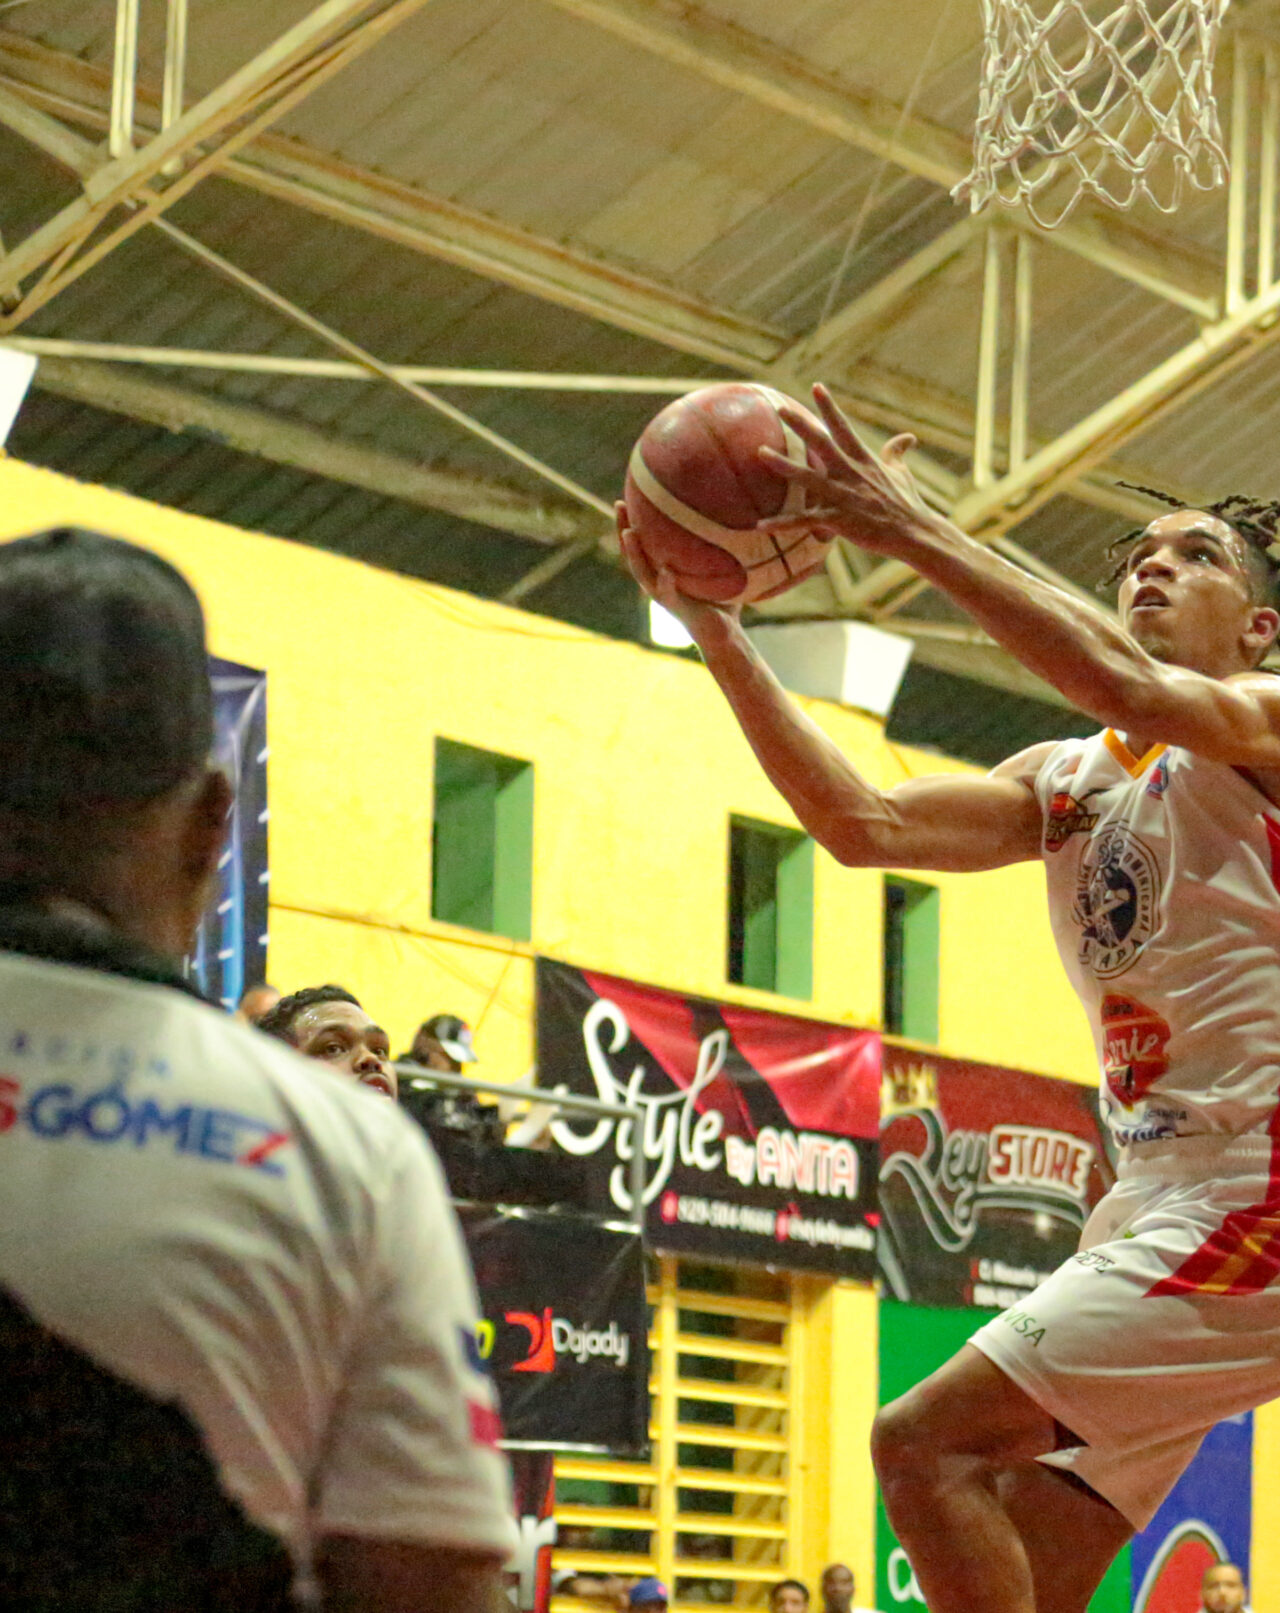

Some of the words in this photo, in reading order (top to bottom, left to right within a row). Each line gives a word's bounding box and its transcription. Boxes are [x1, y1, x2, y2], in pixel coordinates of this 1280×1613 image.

[550, 998, 729, 1211] Style
[756, 1126, 859, 1199] ANITA
[989, 1127, 1091, 1198] STORE
